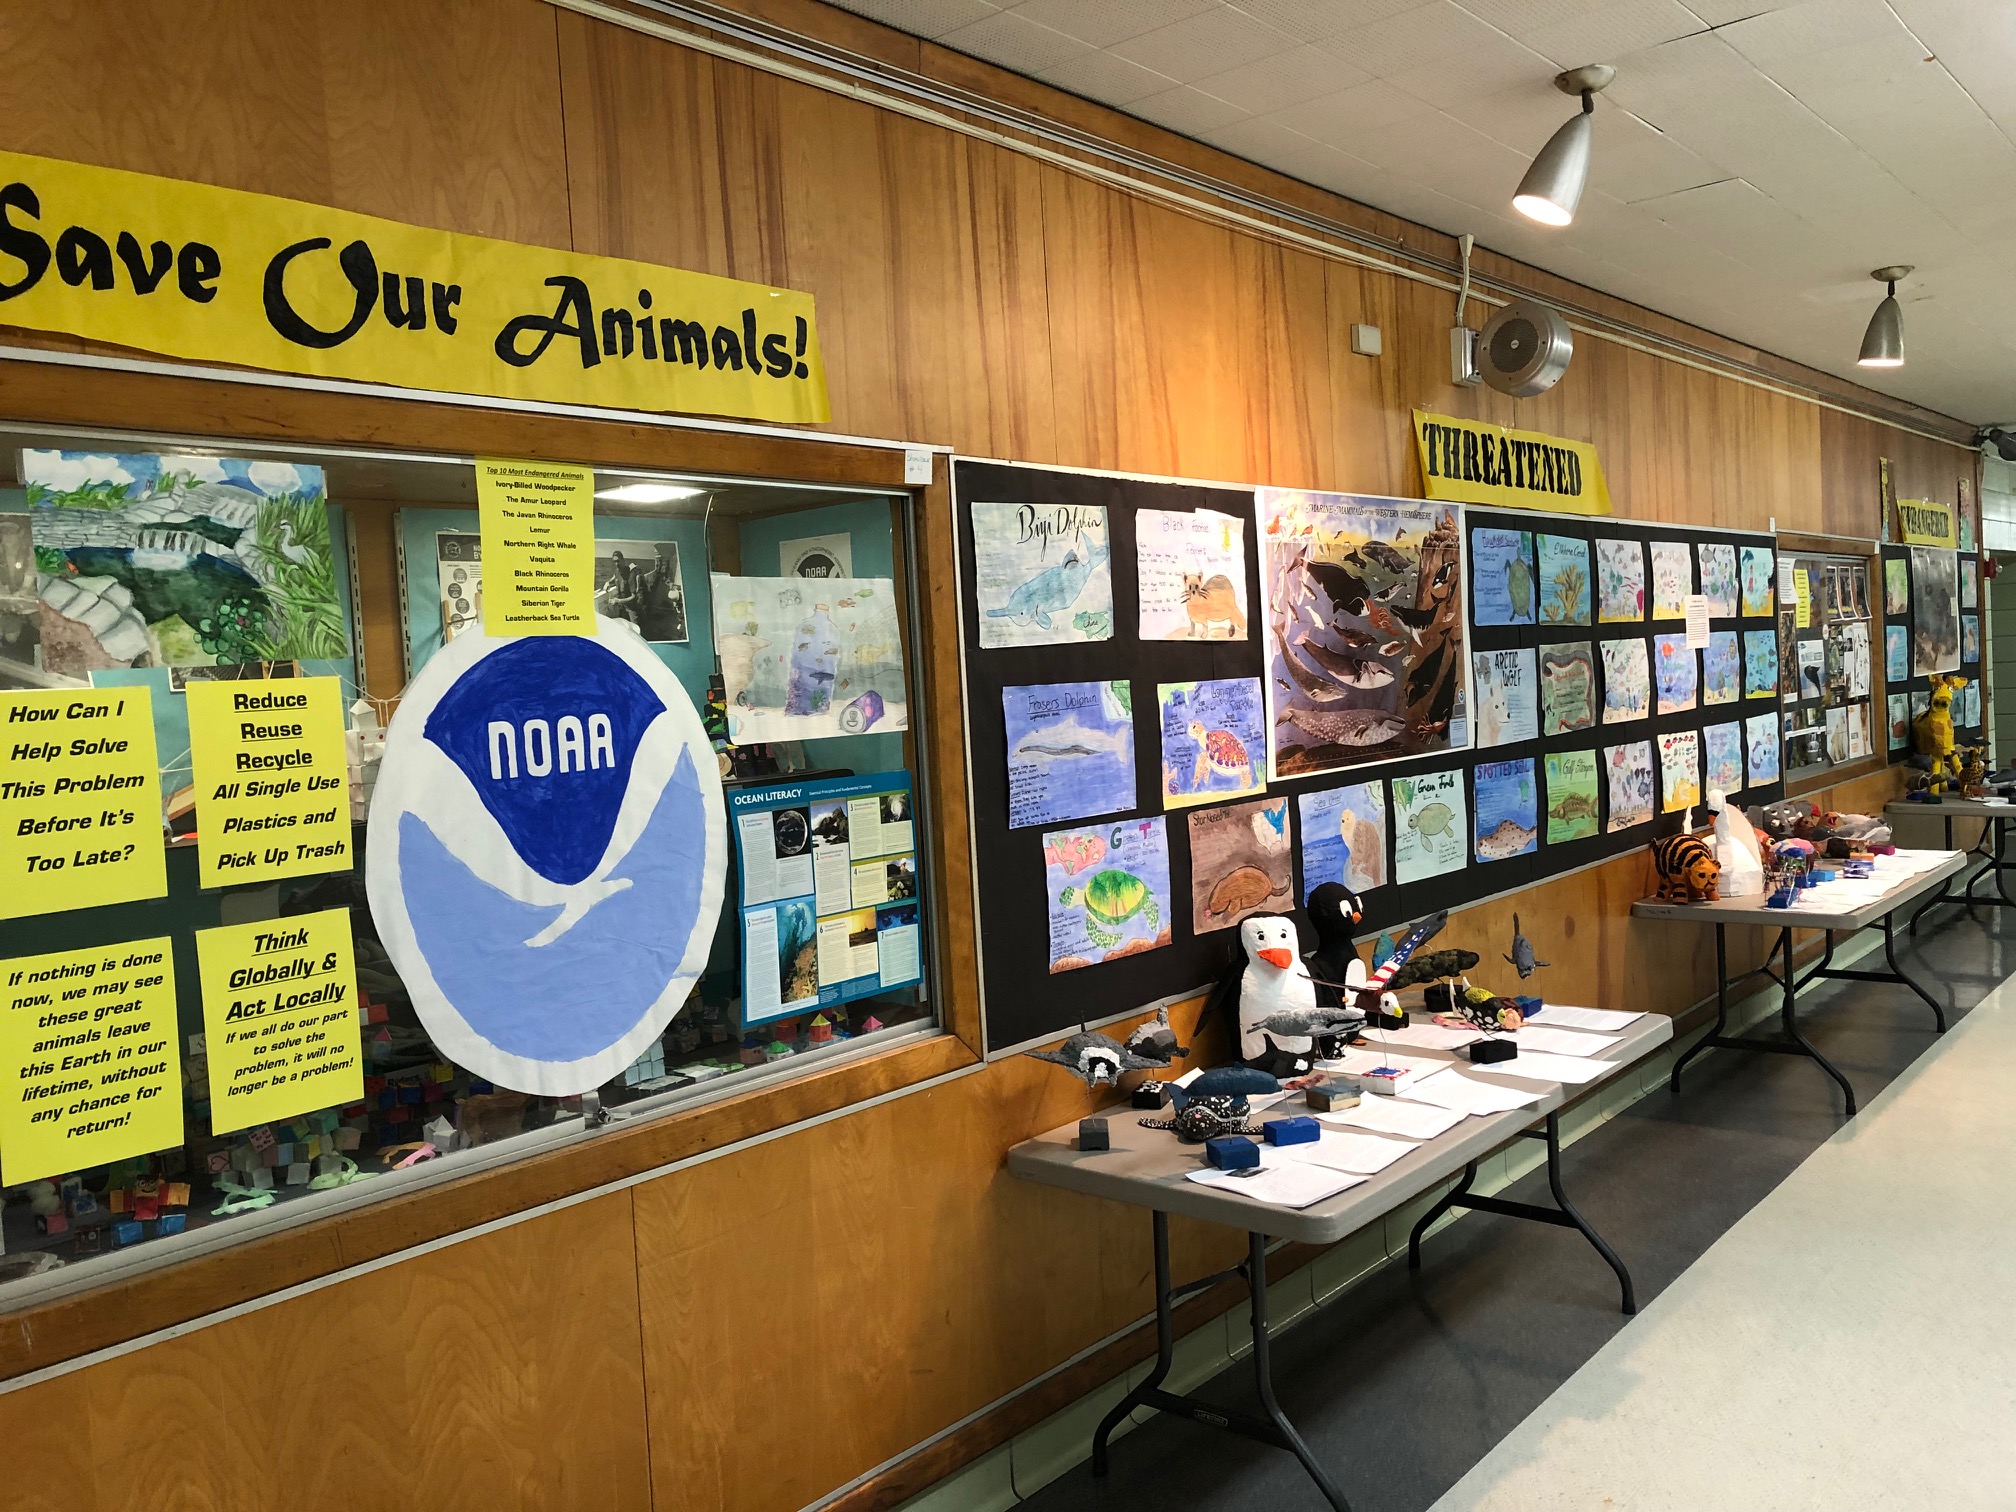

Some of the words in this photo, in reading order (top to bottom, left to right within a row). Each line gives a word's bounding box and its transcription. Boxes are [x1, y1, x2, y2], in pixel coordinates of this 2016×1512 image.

[0, 182, 221, 304] Save
[262, 237, 462, 349] Our
[493, 276, 808, 381] Animals!
[1423, 423, 1582, 496] THREATENED
[496, 481, 532, 489] Ivory-Billed
[534, 483, 575, 492] Woodpecker
[525, 470, 559, 478] Endangered
[561, 472, 584, 480] Animals
[1163, 516, 1184, 532] Black
[538, 541, 555, 549] Right
[806, 566, 826, 578] NOAA
[1495, 651, 1518, 669] ARCTIC
[1503, 669, 1522, 687] WOLF
[9, 705, 58, 723] How
[66, 702, 108, 719] Can
[116, 701, 124, 716] I
[234, 693, 308, 711] Reduce
[1028, 695, 1060, 712] Frasers
[1065, 692, 1097, 708] Dolphin
[241, 722, 303, 740] Reuse
[11, 740, 61, 762] Help
[70, 738, 128, 756] Solve
[236, 748, 313, 770] Recycle
[488, 713, 615, 779] NOAA
[1477, 762, 1511, 780] SPOTTED
[1, 781, 45, 800] This
[54, 773, 145, 795] Problem
[213, 783, 239, 800] All
[245, 779, 301, 798] Single
[307, 775, 340, 791] Use
[735, 794, 763, 805] OCEAN
[766, 789, 802, 801] LITERACY
[17, 814, 92, 836] Before
[100, 809, 135, 827] It's
[223, 815, 297, 834] Plastics
[303, 808, 336, 824] and
[27, 854, 65, 873] Too
[73, 844, 135, 868] Late?
[217, 851, 256, 870] Pick
[264, 848, 289, 866] Up
[296, 841, 345, 860] Trash
[854, 868, 857, 876] 4
[747, 919, 750, 928] 5
[820, 926, 824, 934] 6
[254, 927, 309, 953] Think
[8, 972, 23, 987] If
[28, 961, 96, 984] nothing
[102, 958, 116, 972] is
[122, 952, 163, 969] done
[228, 956, 315, 989] Globally
[322, 953, 337, 971] &
[11, 994, 54, 1010] now,
[61, 988, 87, 1000] we
[93, 981, 129, 998] may
[134, 974, 164, 989] see
[226, 1000, 265, 1021] Act
[274, 982, 347, 1011] Locally
[38, 1010, 88, 1029] these
[94, 998, 142, 1022] great
[226, 1033, 237, 1044] If
[239, 1028, 257, 1041] we
[261, 1023, 277, 1037] all
[280, 1019, 295, 1032] do
[299, 1016, 318, 1029] our
[322, 1009, 348, 1026] part
[32, 1030, 101, 1053] animals
[107, 1020, 151, 1038] leave
[253, 1044, 267, 1056] to
[270, 1037, 302, 1052] solve
[306, 1030, 326, 1044] the
[19, 1061, 56, 1080] this
[61, 1051, 111, 1073] Earth
[117, 1045, 132, 1060] in
[138, 1039, 167, 1055] our
[234, 1057, 289, 1080] problem,
[293, 1052, 303, 1064] it
[306, 1046, 327, 1062] will
[330, 1044, 345, 1056] no
[22, 1078, 94, 1103] lifetime,
[101, 1060, 167, 1085] without
[227, 1081, 266, 1097] longer
[272, 1074, 286, 1088] be
[290, 1073, 298, 1082] a
[301, 1057, 354, 1082] problem!
[31, 1105, 64, 1124] any
[68, 1092, 130, 1115] chance
[136, 1084, 162, 1101] for
[67, 1111, 131, 1138] return!
